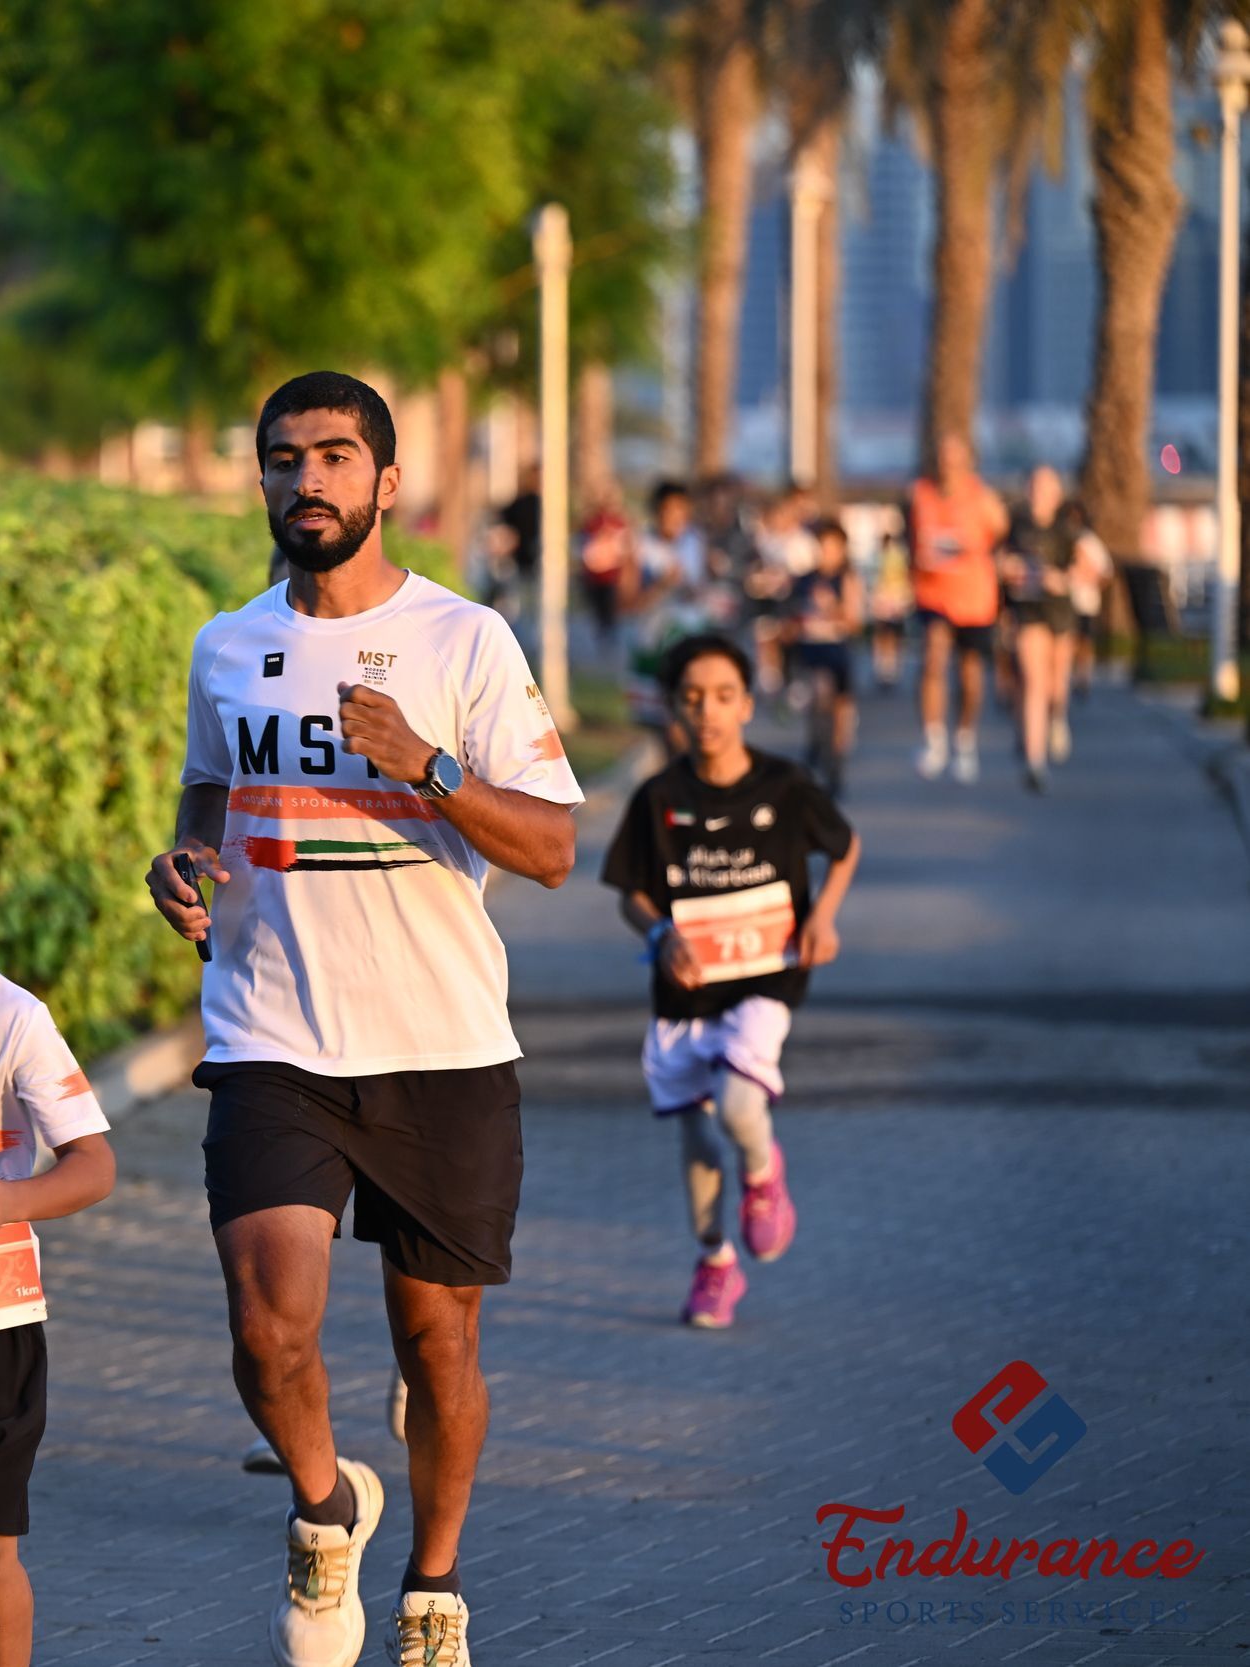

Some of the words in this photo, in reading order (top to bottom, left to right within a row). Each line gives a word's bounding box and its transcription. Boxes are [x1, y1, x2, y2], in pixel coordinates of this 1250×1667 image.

[357, 650, 398, 668] MST
[237, 715, 380, 779] MS
[291, 798, 348, 809] SPORTS
[15, 1285, 40, 1298] 1km
